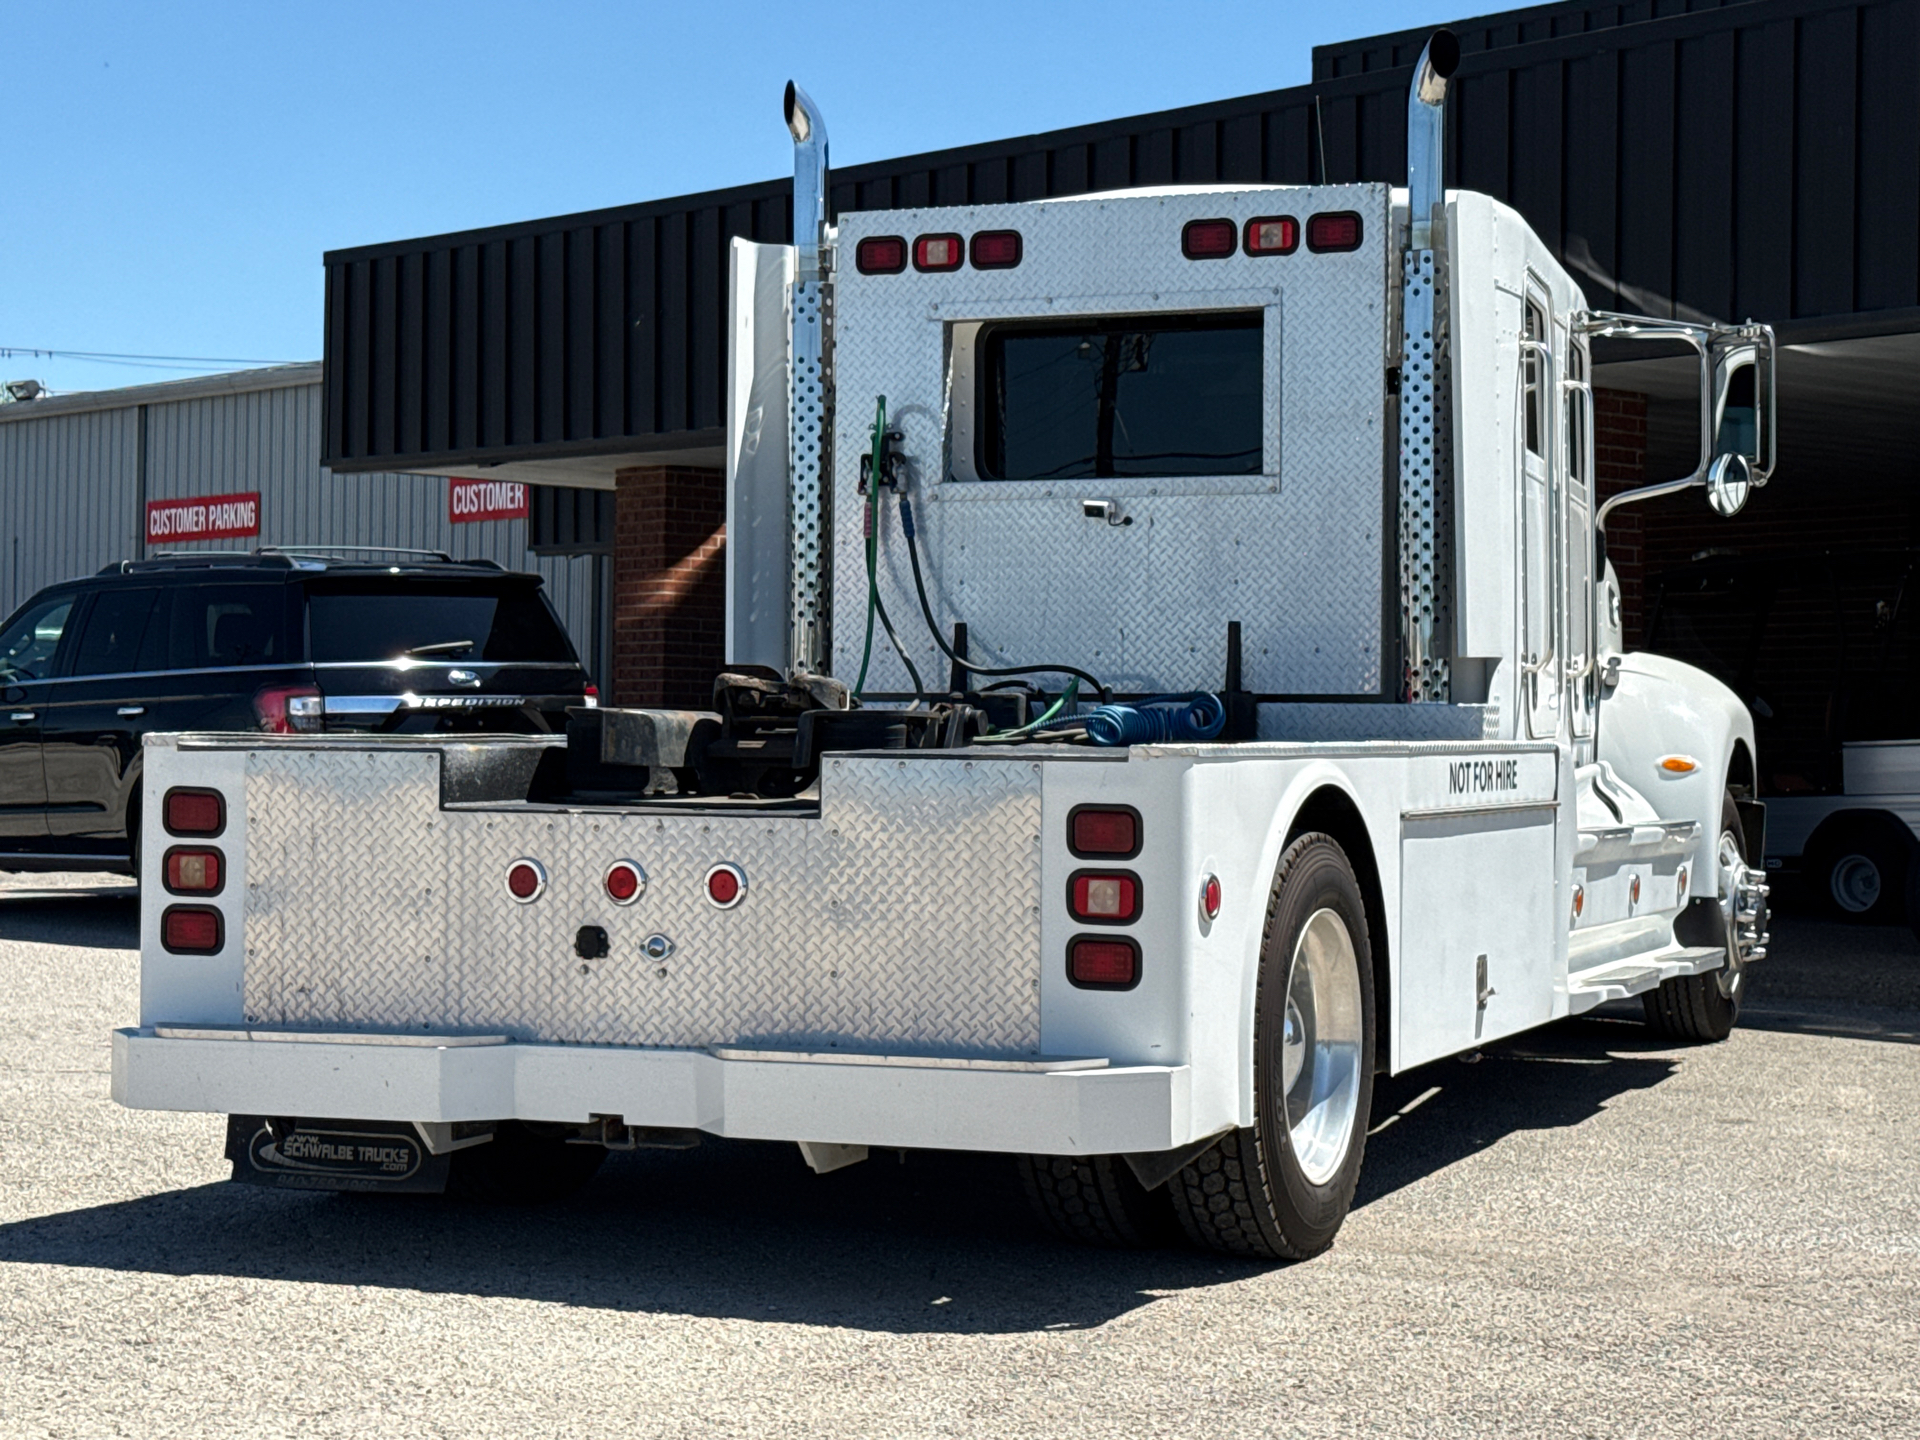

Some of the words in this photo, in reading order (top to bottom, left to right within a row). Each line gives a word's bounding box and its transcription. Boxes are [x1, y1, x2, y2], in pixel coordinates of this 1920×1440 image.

[453, 482, 524, 515] CUSTOMER
[150, 505, 206, 536] CUSTOMER
[208, 501, 256, 531] PARKING
[408, 697, 526, 708] XPEDITION
[1449, 761, 1471, 795] NOT
[1473, 760, 1493, 793] FOR
[1495, 759, 1518, 792] HIRE
[283, 1142, 354, 1161] SCHWALBE
[358, 1146, 409, 1163] TRUCKS
[379, 1162, 408, 1172] .com
